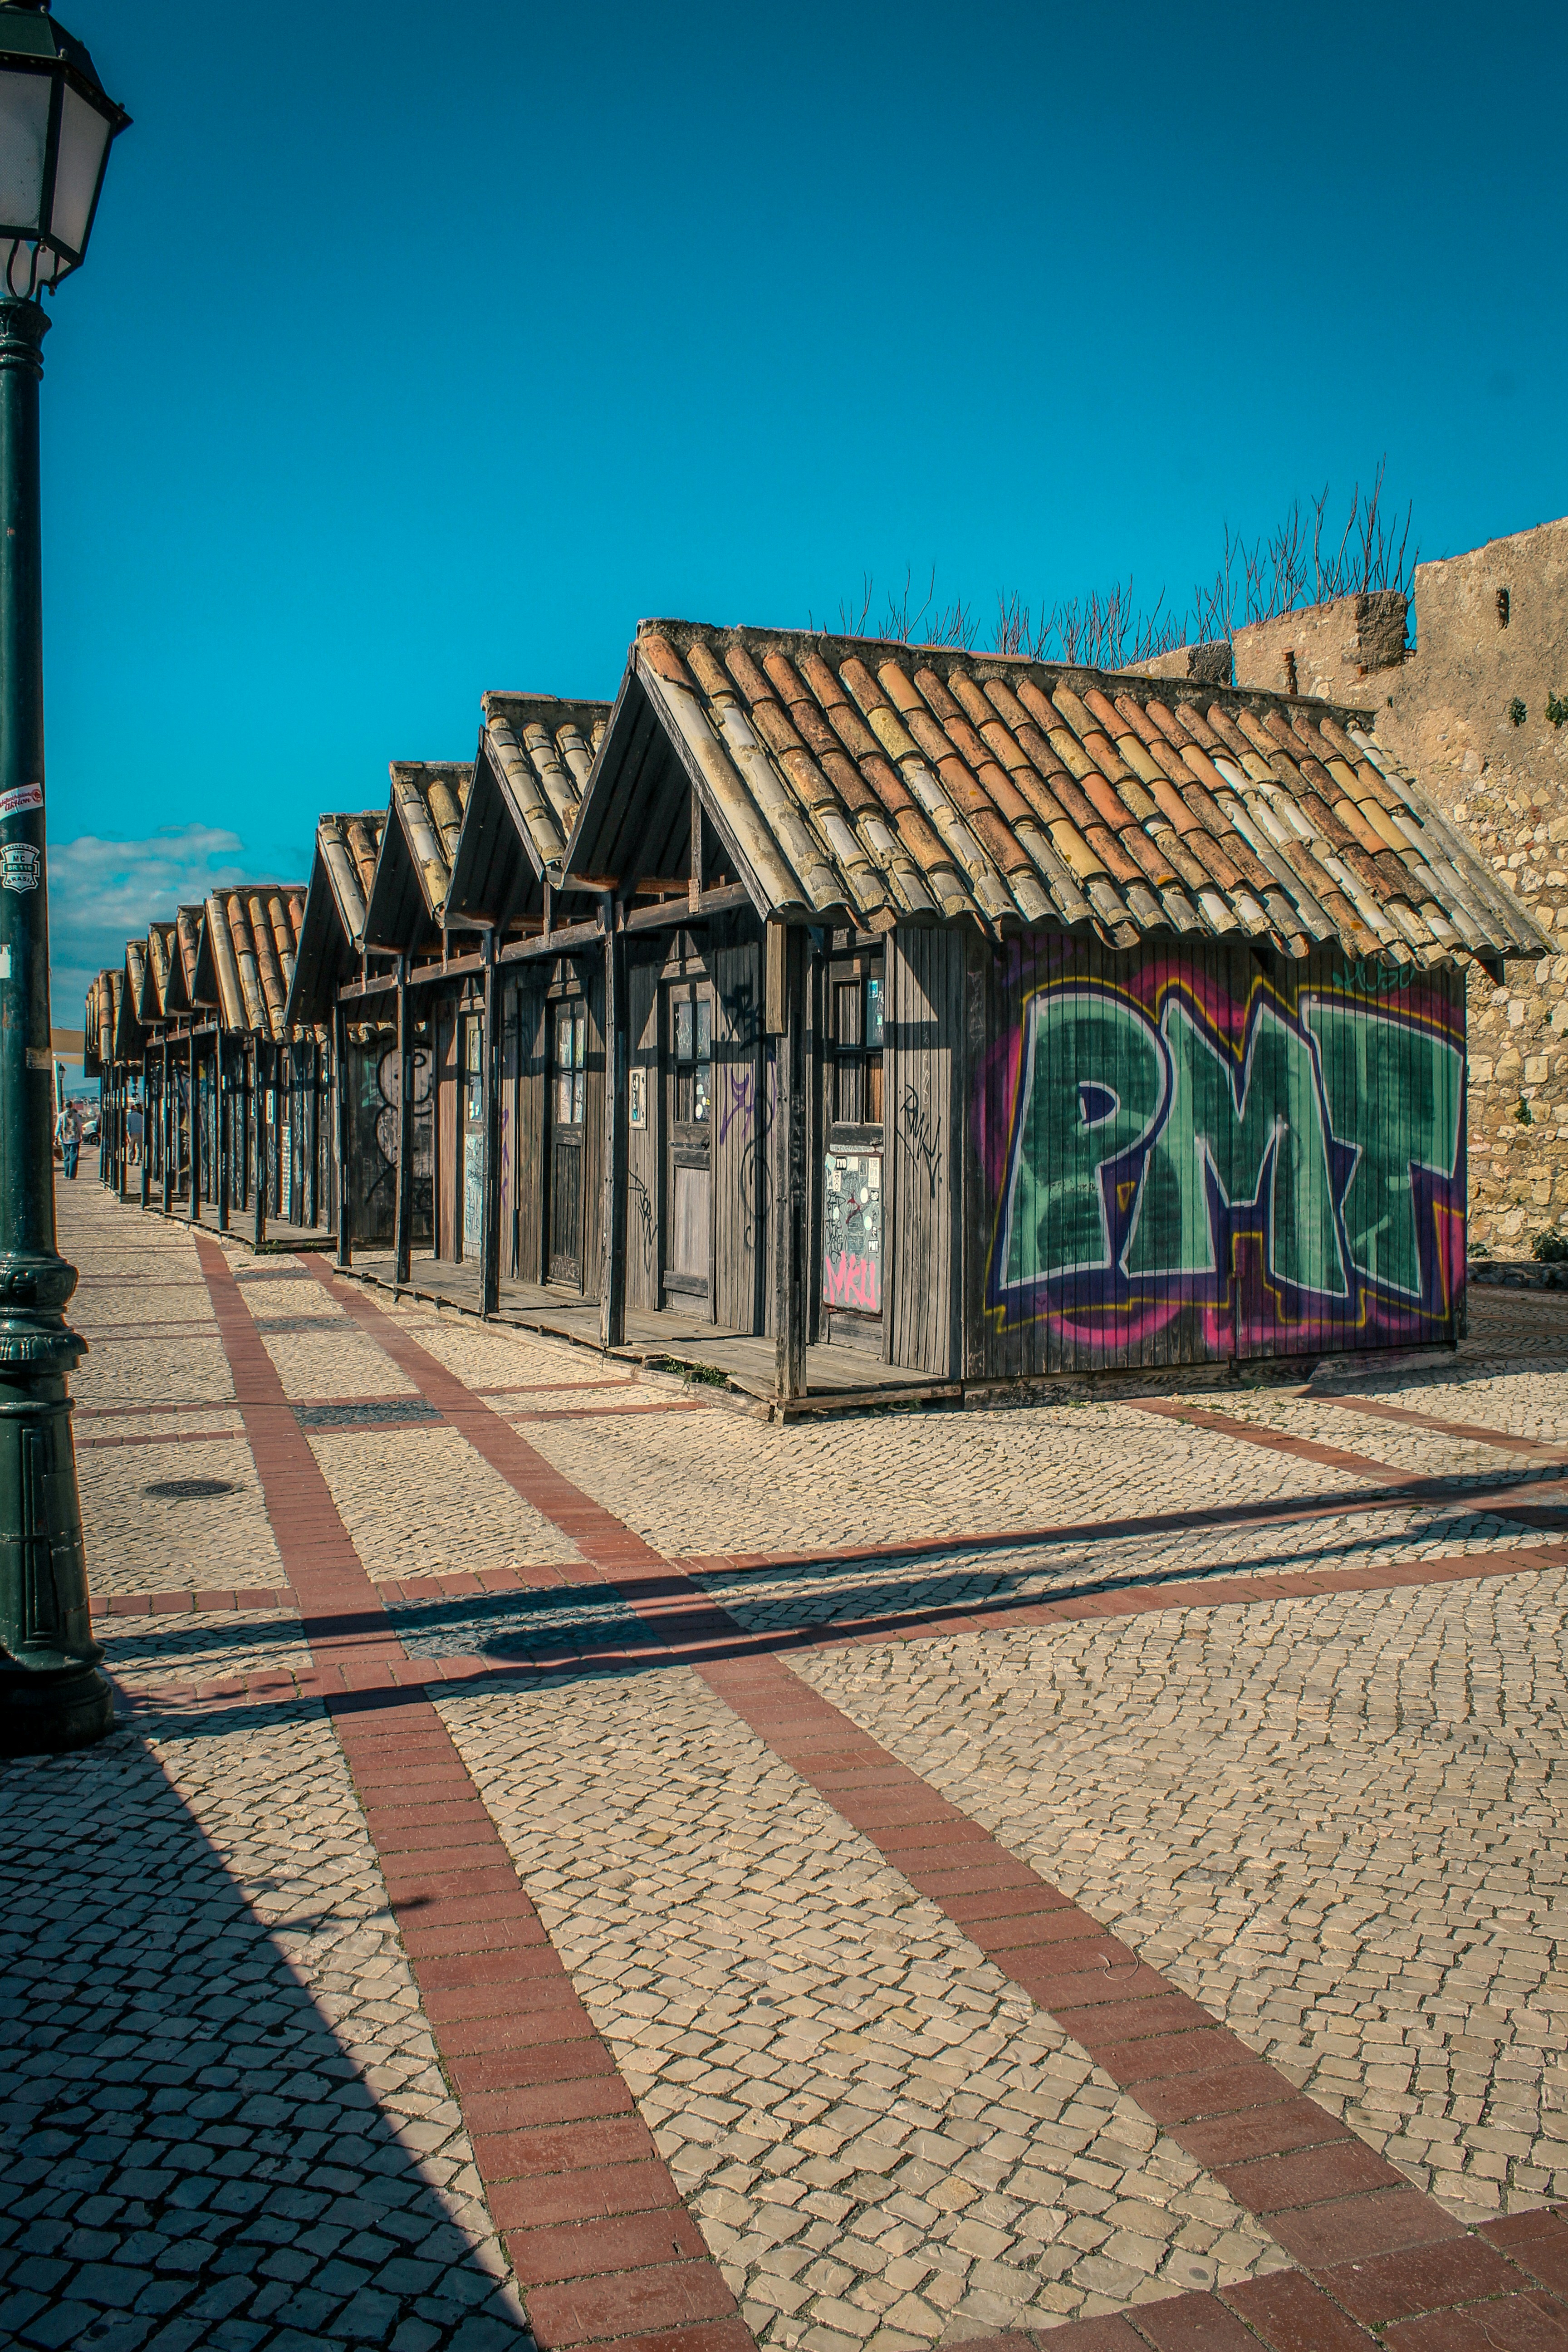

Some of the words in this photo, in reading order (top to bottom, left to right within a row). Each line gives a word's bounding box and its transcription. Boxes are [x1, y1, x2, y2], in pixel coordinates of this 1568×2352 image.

[7, 876, 34, 885] BRASIL
[998, 991, 1465, 1298] PMT
[868, 1240, 878, 1250] PMT
